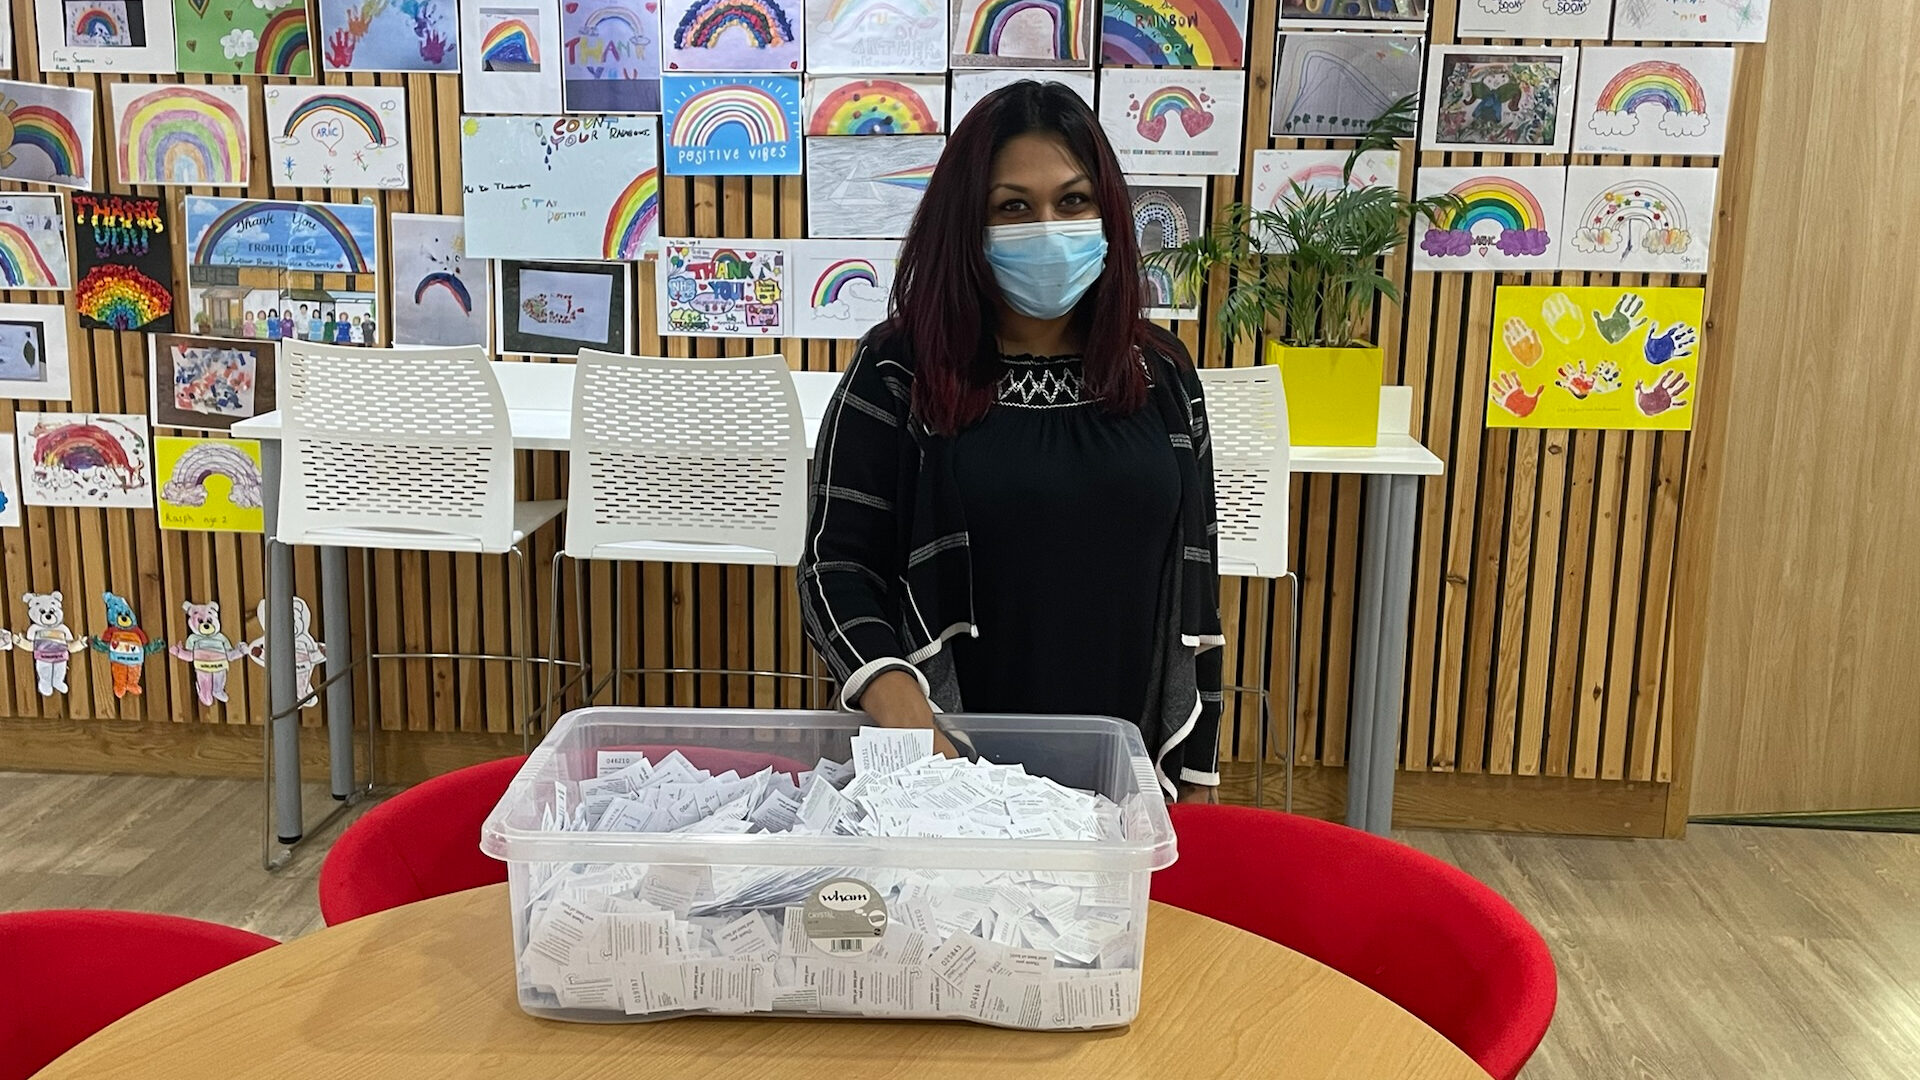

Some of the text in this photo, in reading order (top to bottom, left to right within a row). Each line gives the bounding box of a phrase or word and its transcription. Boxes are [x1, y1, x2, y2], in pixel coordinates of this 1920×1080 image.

[1135, 11, 1199, 28] RAINBOW
[553, 117, 619, 136] COUNT
[550, 130, 598, 151] YOUR
[521, 197, 558, 210] STAY
[236, 212, 318, 234] Thank You
[686, 260, 755, 280] THANK
[822, 890, 867, 902] wham
[942, 945, 962, 966] 025843
